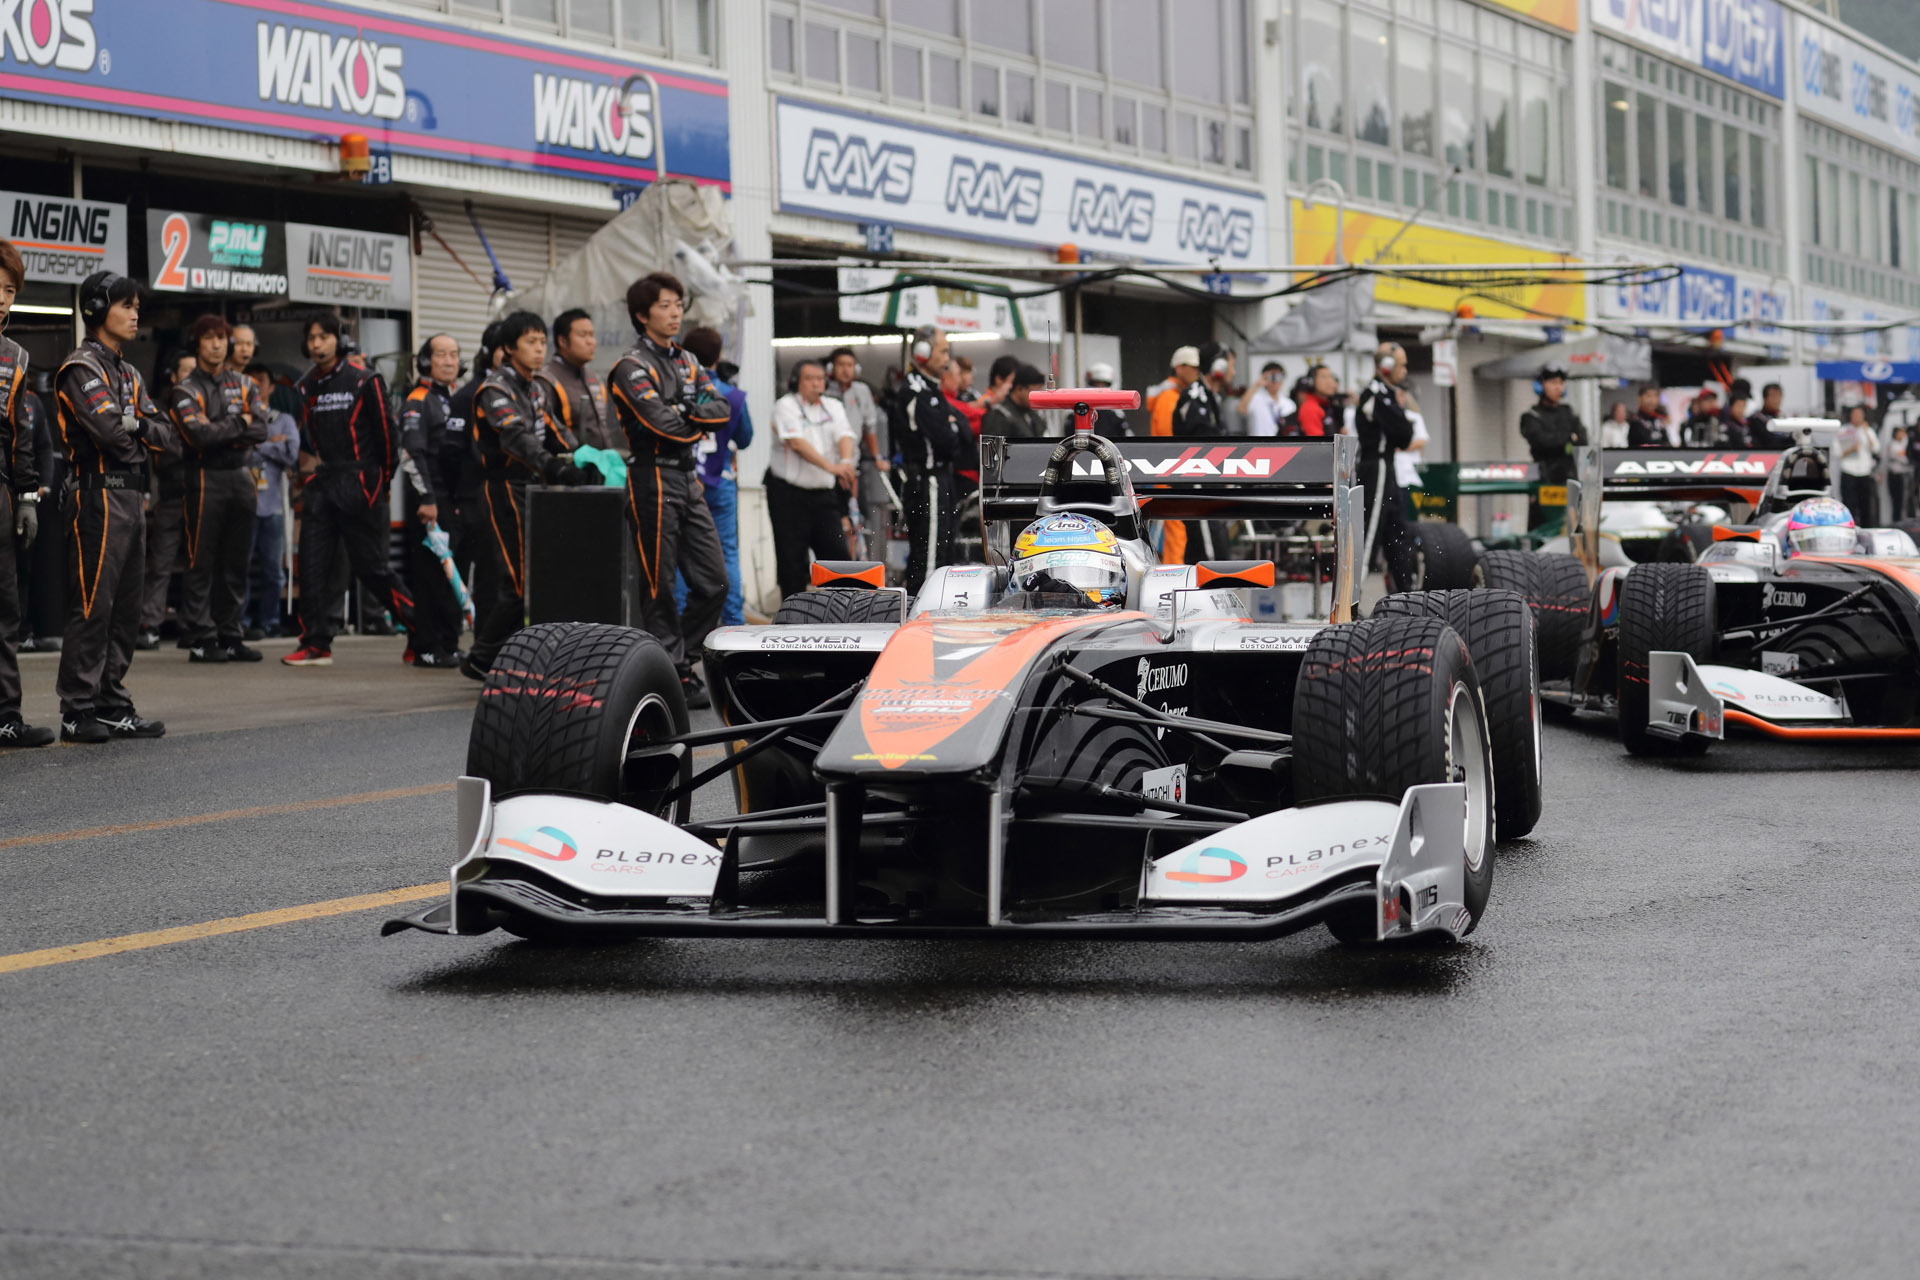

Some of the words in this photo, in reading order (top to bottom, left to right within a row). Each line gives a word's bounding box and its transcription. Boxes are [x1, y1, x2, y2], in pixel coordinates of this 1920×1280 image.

[533, 72, 654, 159] WAKOS
[803, 127, 916, 204] RAYS
[945, 154, 1043, 225] RAYS
[11, 199, 110, 245] INGING
[1068, 178, 1156, 242] RAYS
[1178, 198, 1254, 260] RAYS
[21, 251, 104, 277] OTORSPORT
[153, 212, 191, 291] 2
[308, 231, 394, 273] INGING
[306, 276, 391, 301] MOTORSPORT
[1614, 461, 1766, 474] ADVAN
[1057, 521, 1080, 529] Arai
[1773, 591, 1807, 607] CERUMO
[761, 635, 862, 643] ROWEN
[1148, 663, 1188, 692] CERUMO
[590, 862, 645, 875] CARS
[1265, 862, 1320, 880] CARS
